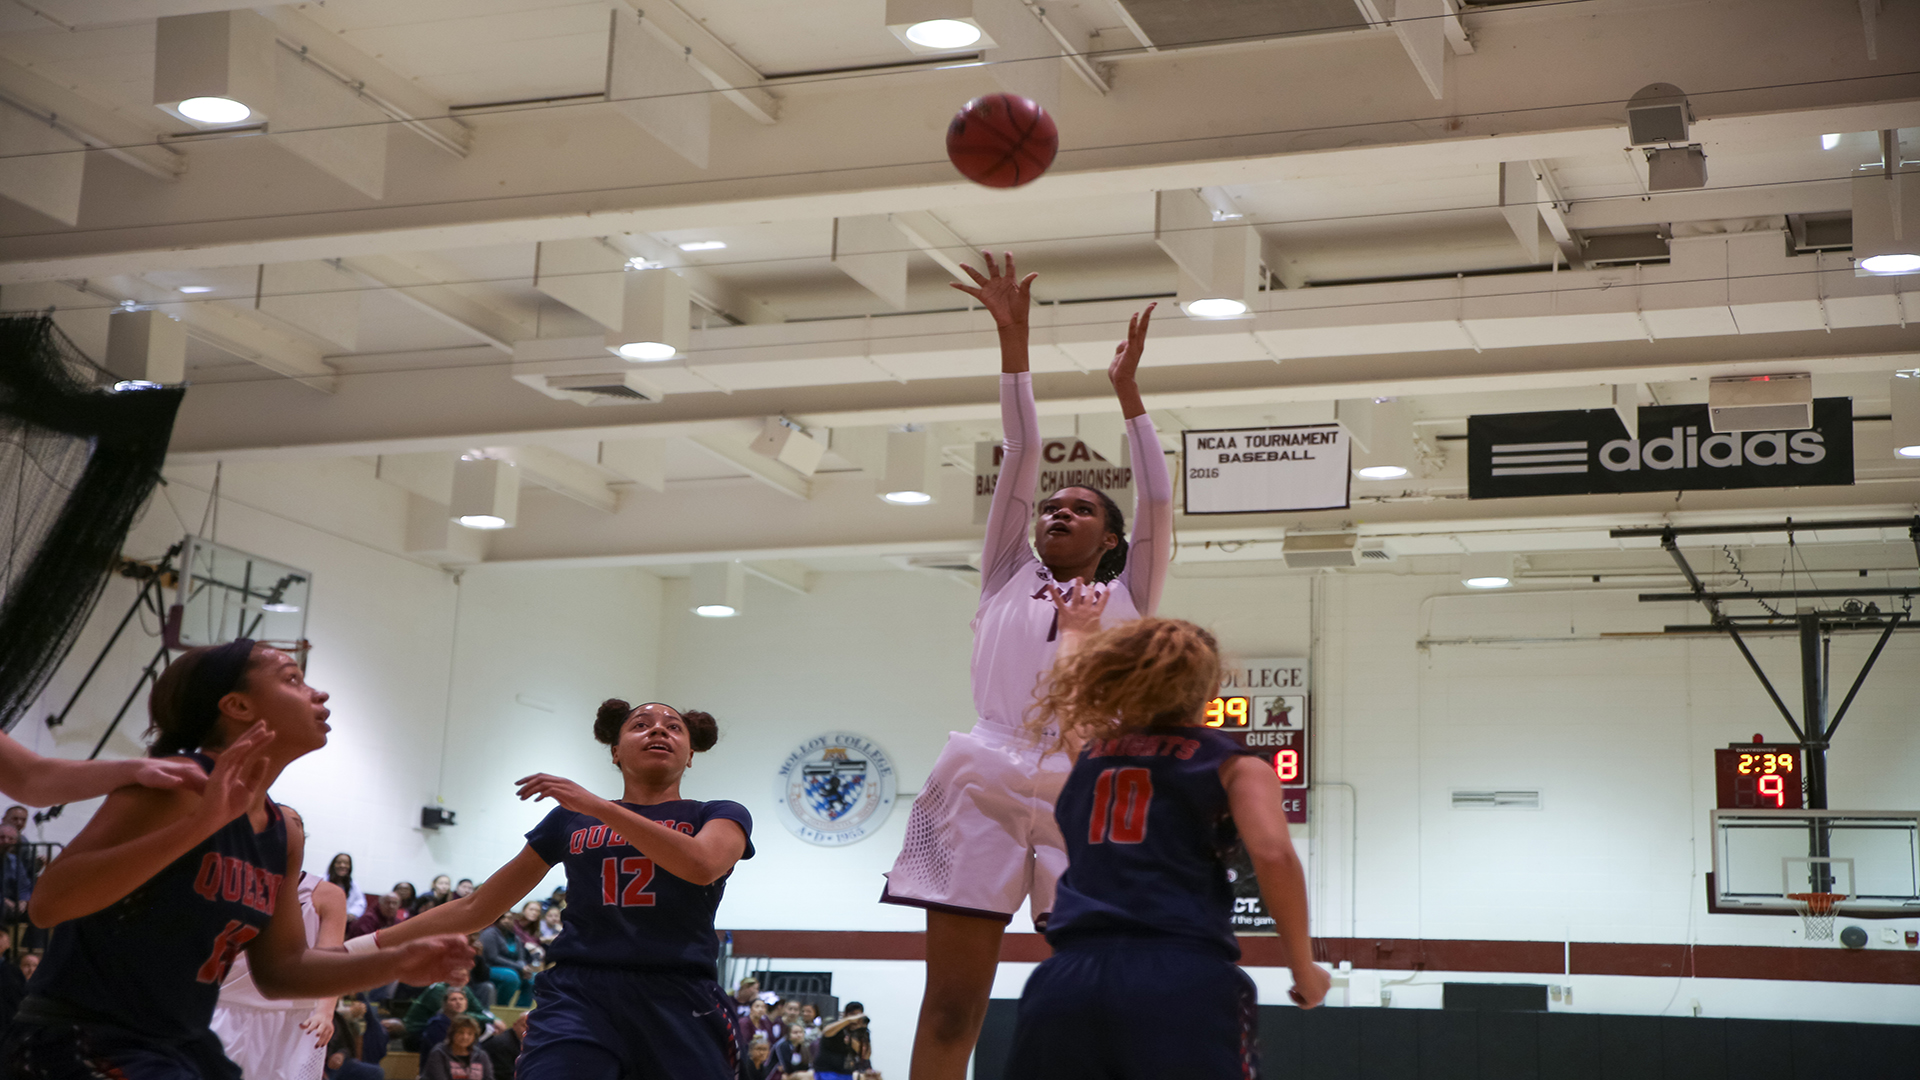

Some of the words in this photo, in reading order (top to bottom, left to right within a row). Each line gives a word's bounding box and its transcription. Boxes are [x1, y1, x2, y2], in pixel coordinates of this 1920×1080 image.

[1197, 436, 1237, 450] NCAA
[1244, 431, 1339, 448] TOURNAMENT
[1598, 425, 1826, 472] adidas
[1218, 450, 1315, 464] BASEBALL
[1040, 468, 1131, 492] CHAMPIONSHIP
[1189, 468, 1219, 479] 2016
[1219, 668, 1303, 689] OLLEGE
[1246, 732, 1295, 746] GUEST
[835, 735, 892, 778] COLLEGE
[1275, 749, 1299, 781] 8
[1738, 753, 1793, 774] 2:39
[1759, 774, 1784, 807] 9
[1088, 767, 1154, 845] 10
[193, 851, 284, 917] QUEEN
[601, 856, 656, 907] 12
[1253, 916, 1277, 927] gam
